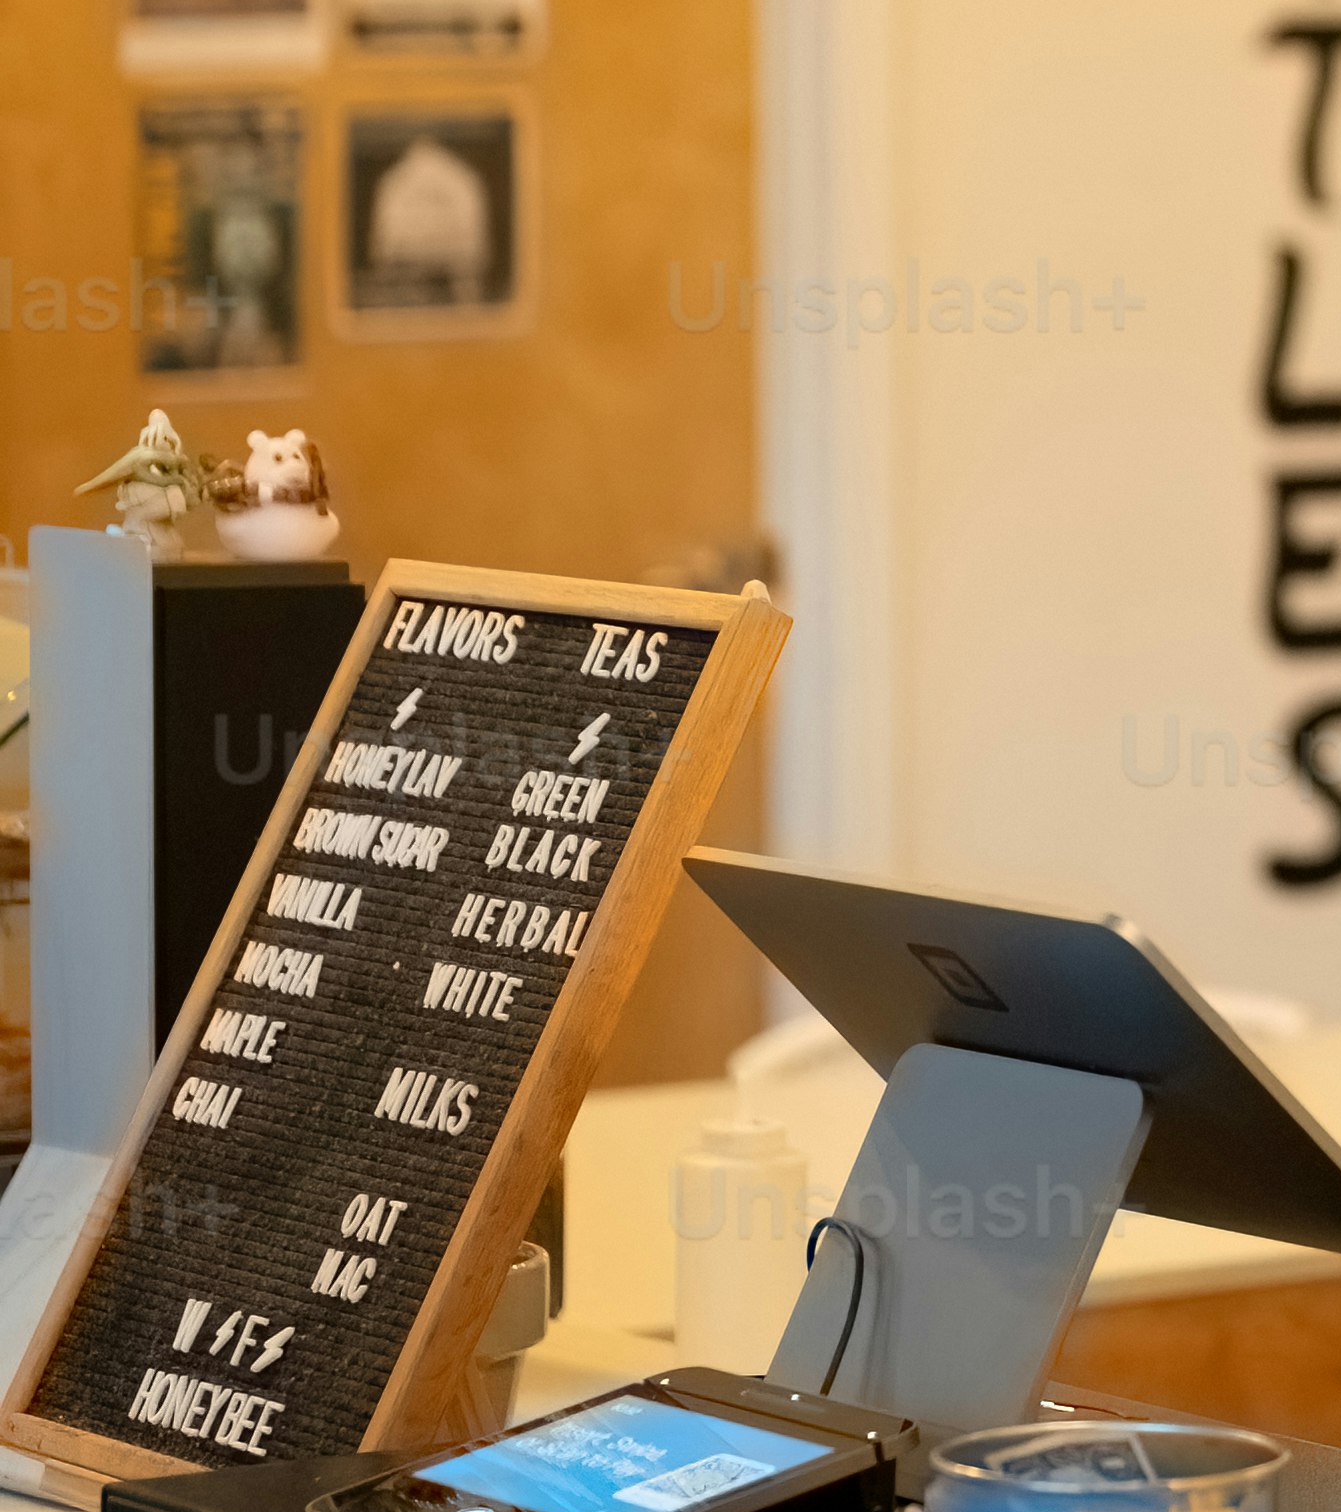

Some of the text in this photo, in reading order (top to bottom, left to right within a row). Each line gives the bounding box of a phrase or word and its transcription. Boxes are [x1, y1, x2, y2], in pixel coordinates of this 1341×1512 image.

[383, 600, 525, 664] FLAVORS
[580, 623, 669, 683] TEAS
[510, 770, 610, 824] GREEN
[293, 807, 450, 873] BROWN SUGAR
[485, 824, 601, 882] BLACK
[266, 873, 363, 931] VANILLA
[451, 893, 589, 958] HERBAL
[233, 940, 324, 999] MOCHA
[423, 961, 523, 1022] WHITE
[200, 1007, 286, 1064] MAPLE
[172, 1076, 242, 1129] CHAI
[374, 1066, 479, 1136] MILKS
[340, 1193, 408, 1246] OAT
[127, 1368, 286, 1457] HONEYBEE
